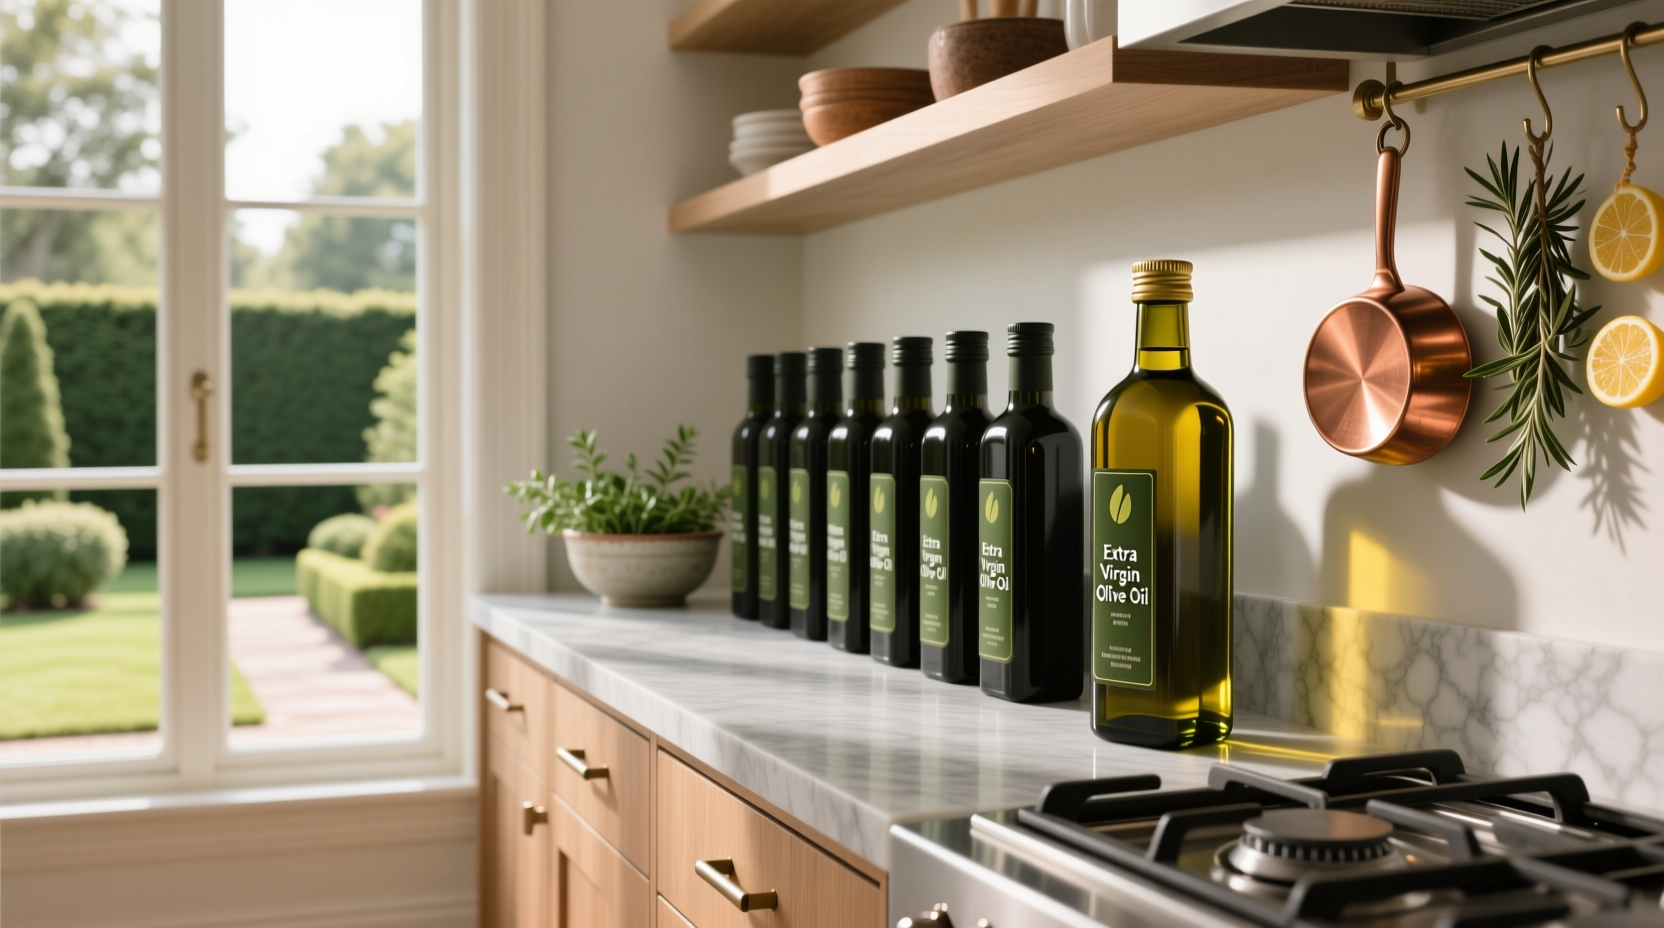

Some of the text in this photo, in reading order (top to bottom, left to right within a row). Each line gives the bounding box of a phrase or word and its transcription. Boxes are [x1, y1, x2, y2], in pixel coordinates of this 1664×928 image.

[1103, 543, 1138, 562] Extra
[1099, 562, 1140, 587] Virgin
[1096, 584, 1149, 605] Olive Oil
